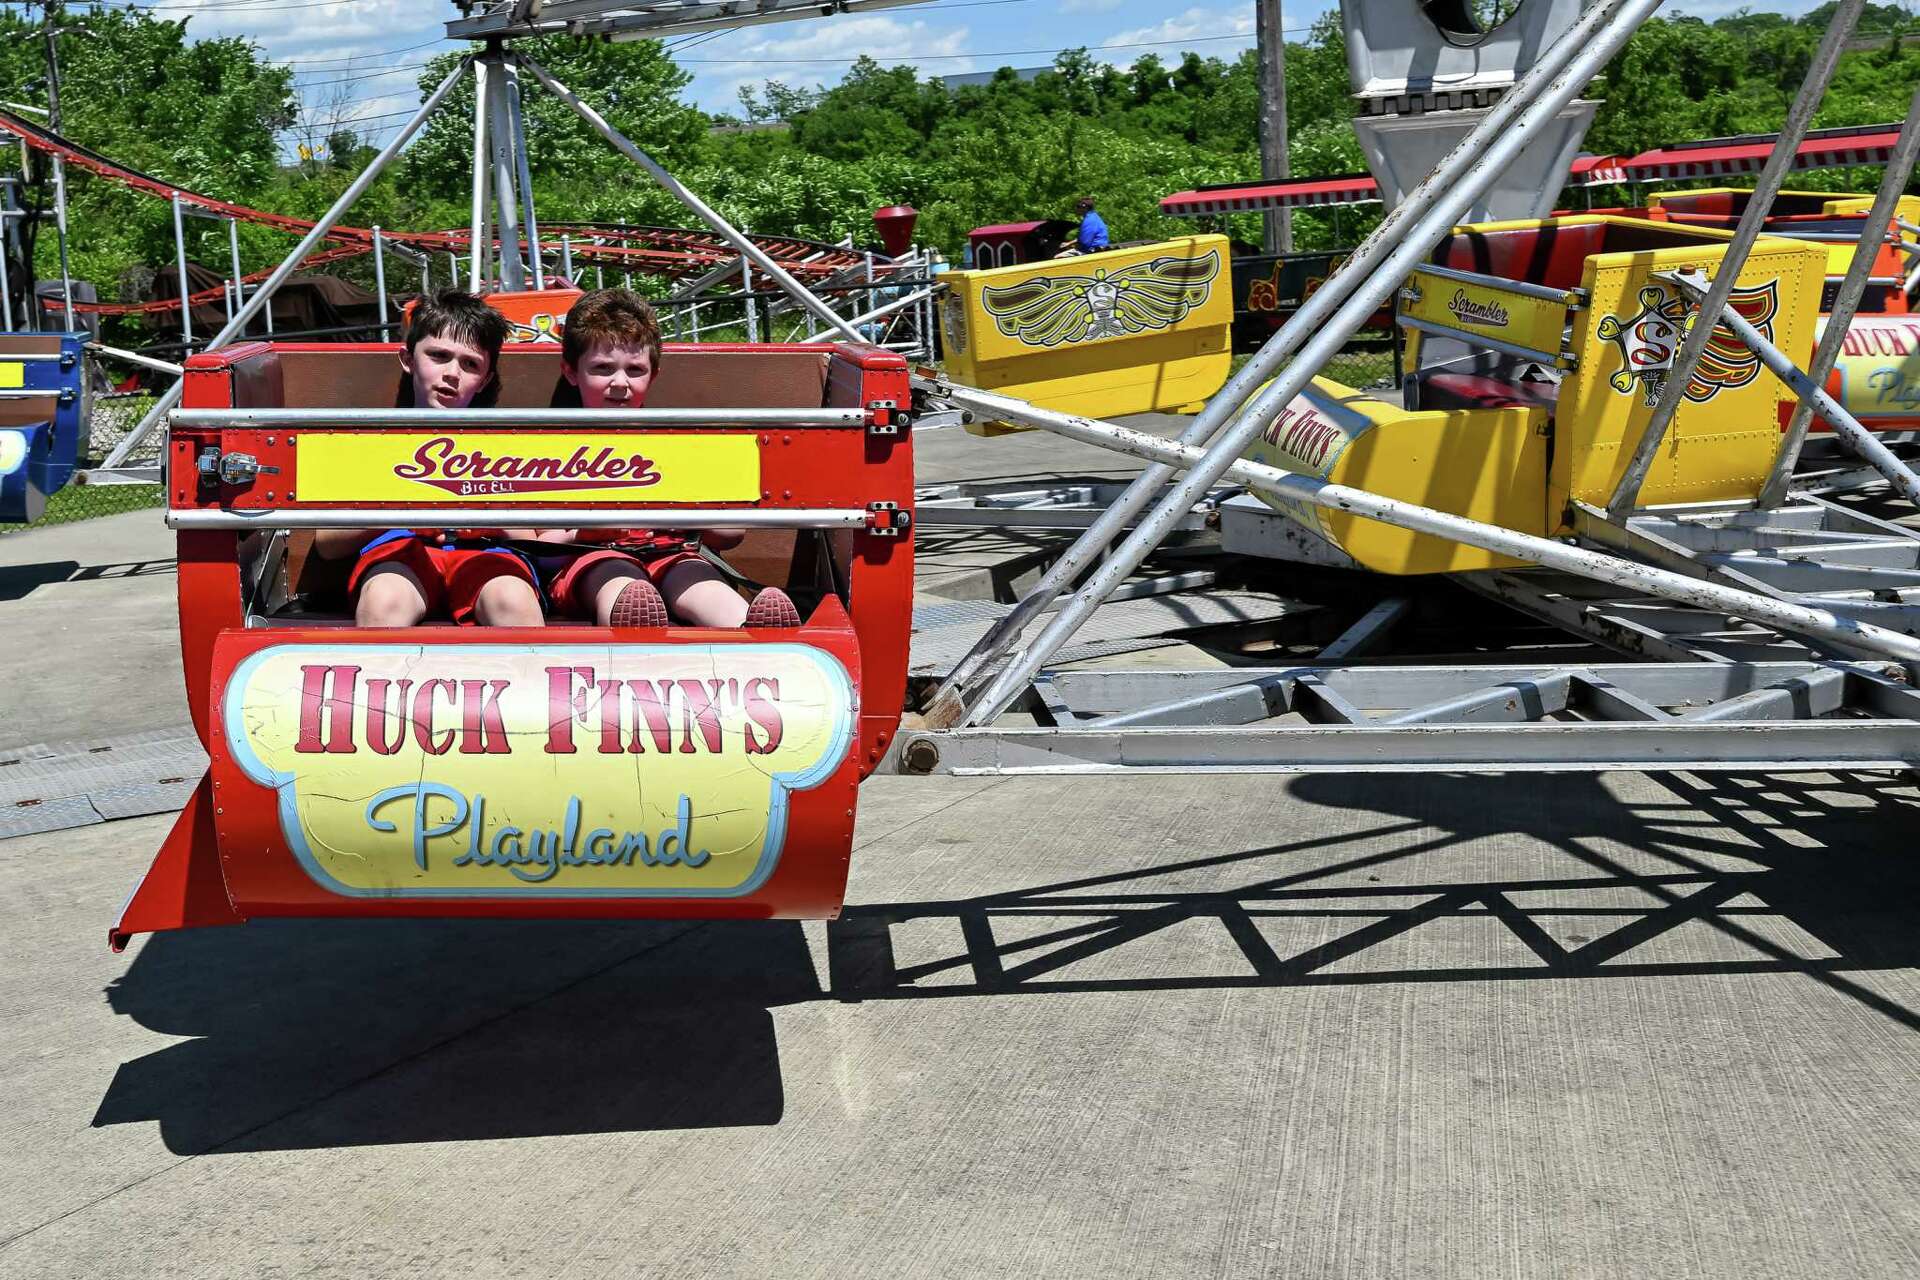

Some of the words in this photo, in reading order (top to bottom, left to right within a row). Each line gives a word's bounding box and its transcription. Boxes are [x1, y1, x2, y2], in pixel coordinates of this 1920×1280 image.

[1448, 287, 1509, 327] Scrambler
[394, 437, 662, 481] Scrambler
[460, 480, 487, 494] BIG
[294, 664, 512, 755] HUCK
[544, 666, 784, 754] FINN'S
[364, 782, 711, 882] Playland
